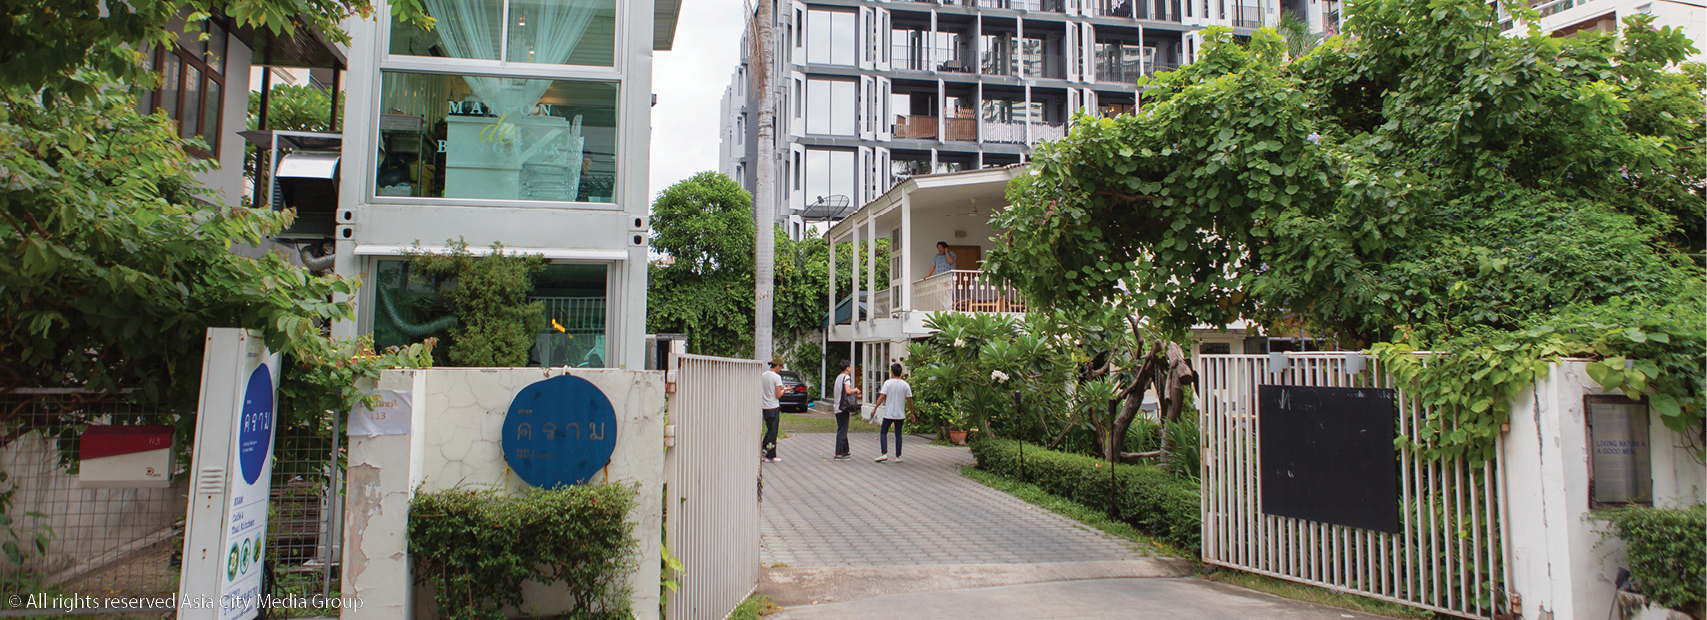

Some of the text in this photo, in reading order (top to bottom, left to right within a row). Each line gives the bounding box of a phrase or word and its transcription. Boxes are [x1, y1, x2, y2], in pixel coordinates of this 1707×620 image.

[448, 101, 552, 116] MAISON
[479, 111, 515, 144] de
[437, 140, 561, 155] BANGKOK
[370, 412, 386, 420] 113
[517, 422, 605, 440] คราม
[148, 437, 161, 446] 113
[1596, 440, 1618, 448] LIVING
[1602, 447, 1621, 455] GOOD
